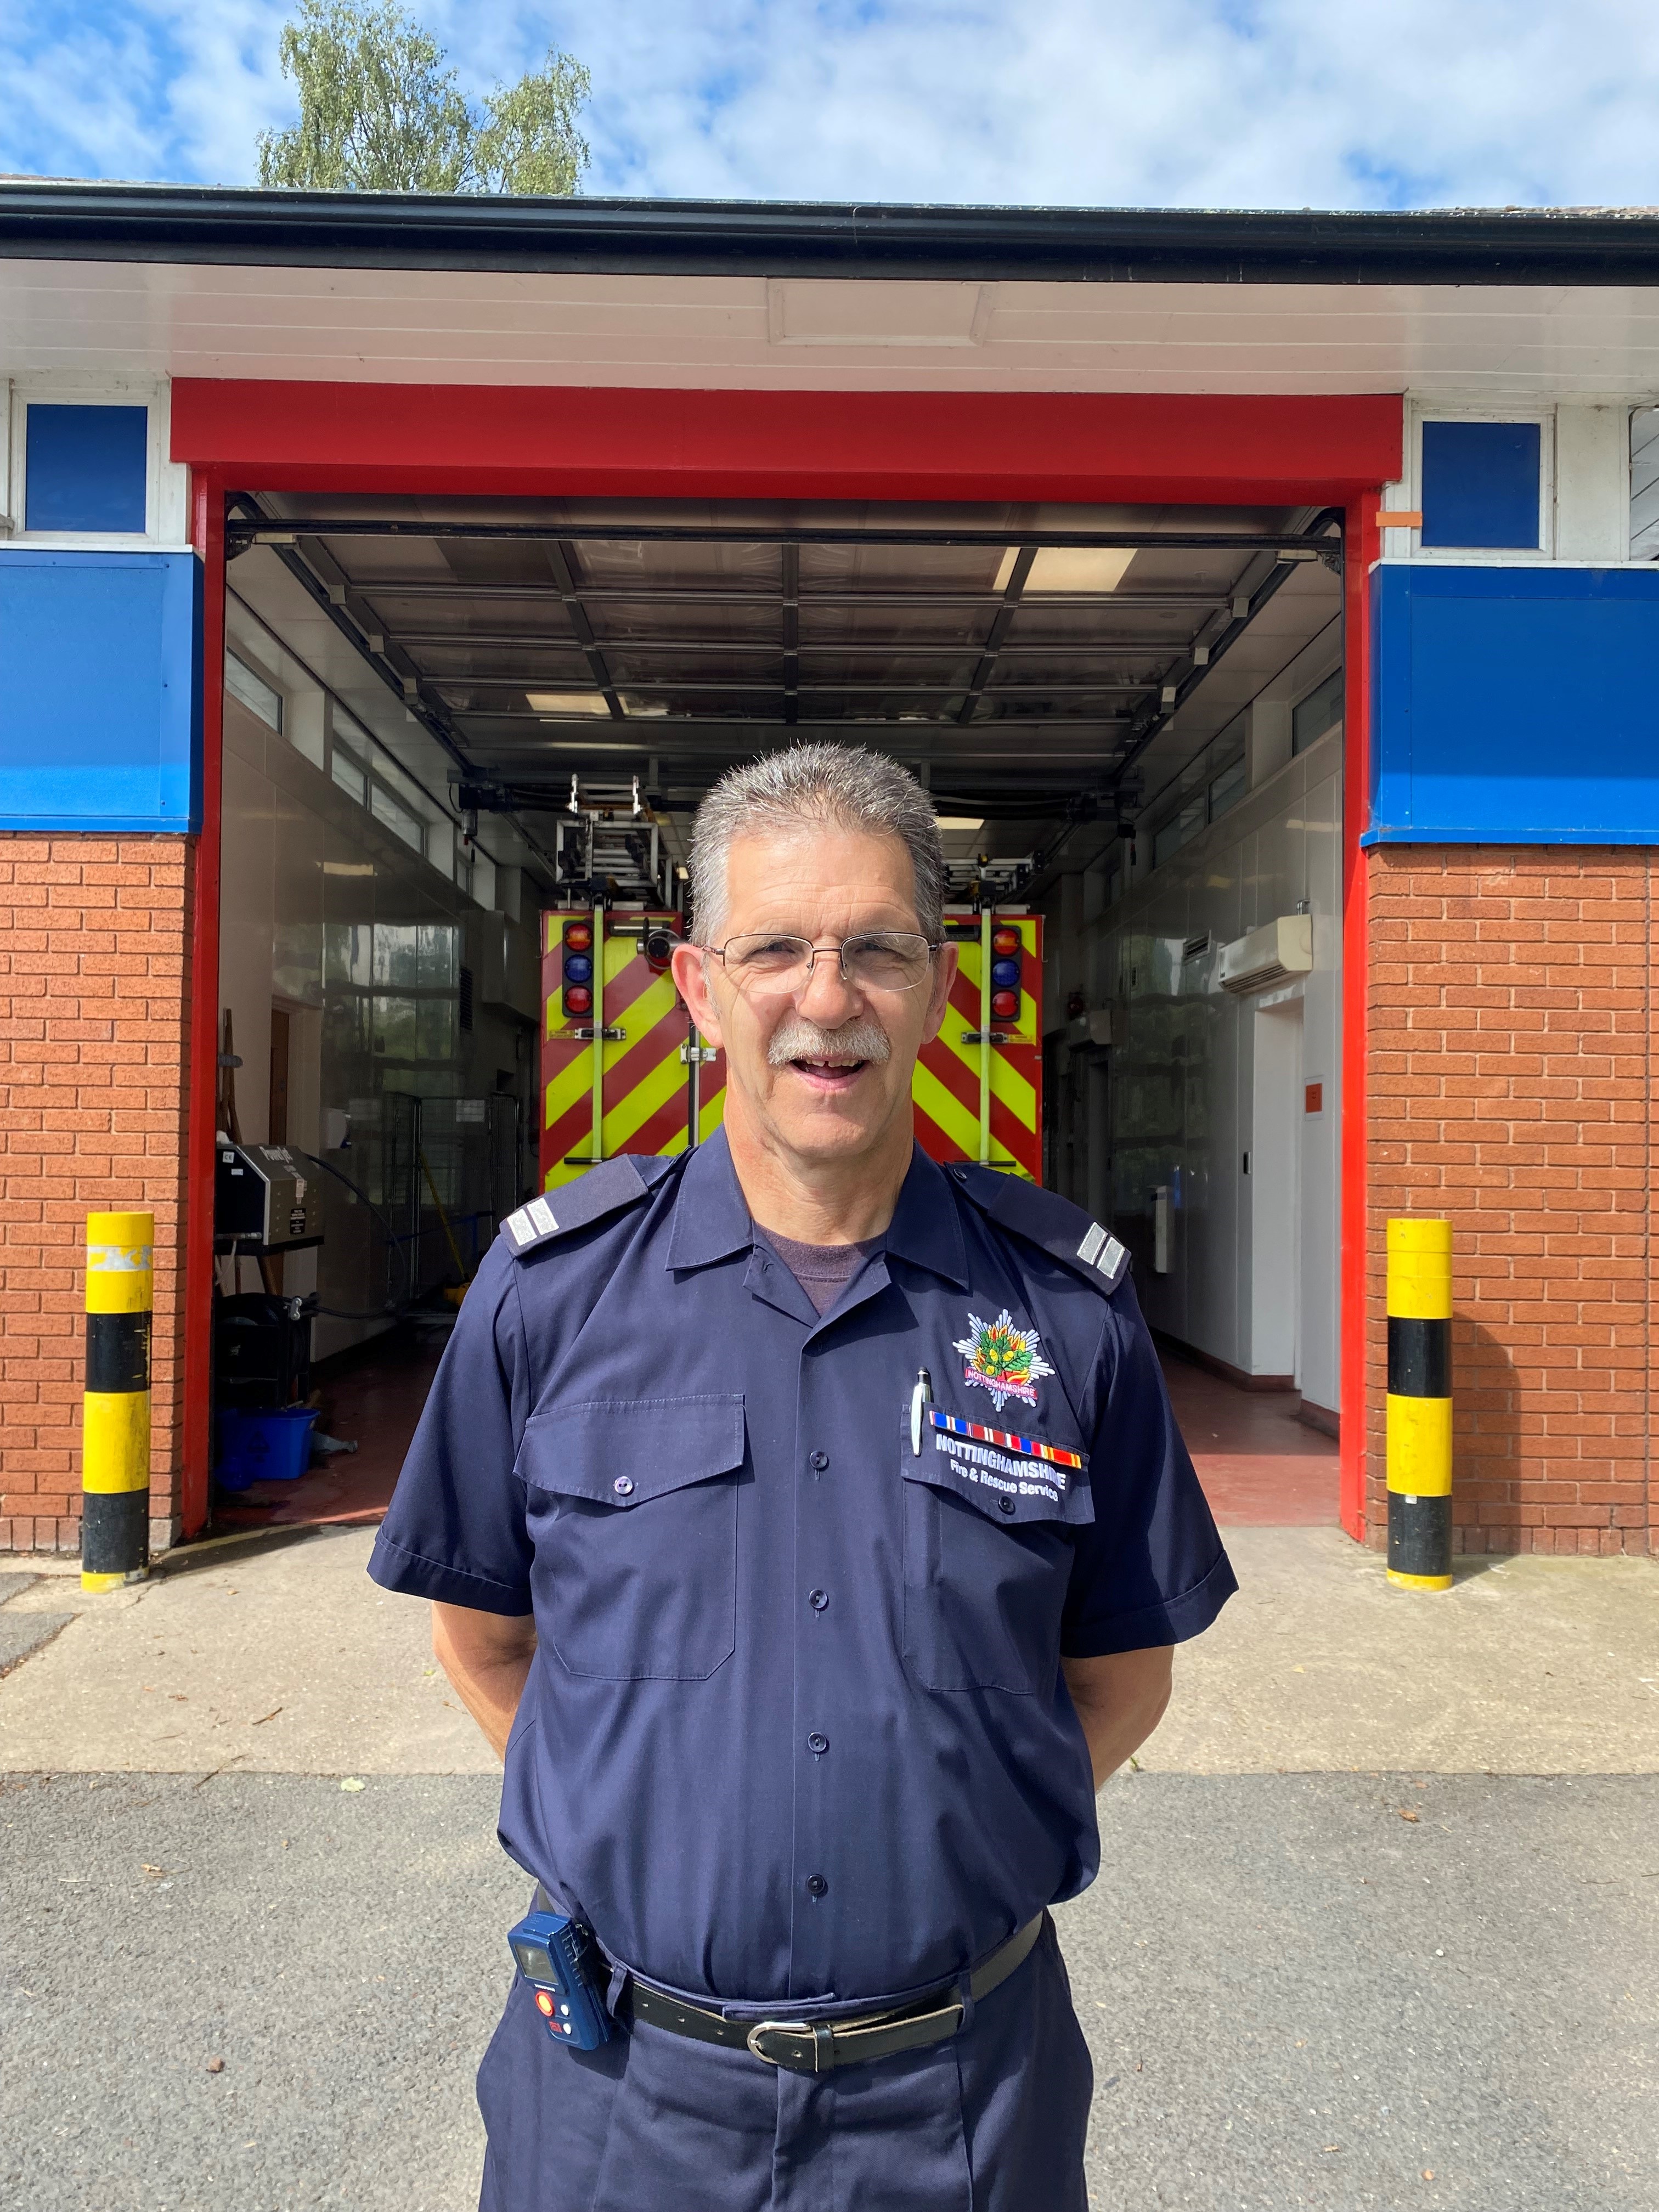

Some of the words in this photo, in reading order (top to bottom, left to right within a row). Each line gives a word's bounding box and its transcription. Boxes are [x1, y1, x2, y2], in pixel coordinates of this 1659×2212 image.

[968, 1370, 1034, 1397] NOTTINGHAMSHIRE
[950, 1459, 968, 1478] Fire
[969, 1468, 979, 1482] &
[981, 1470, 1018, 1493] Rescue
[1019, 1482, 1058, 1502] Service
